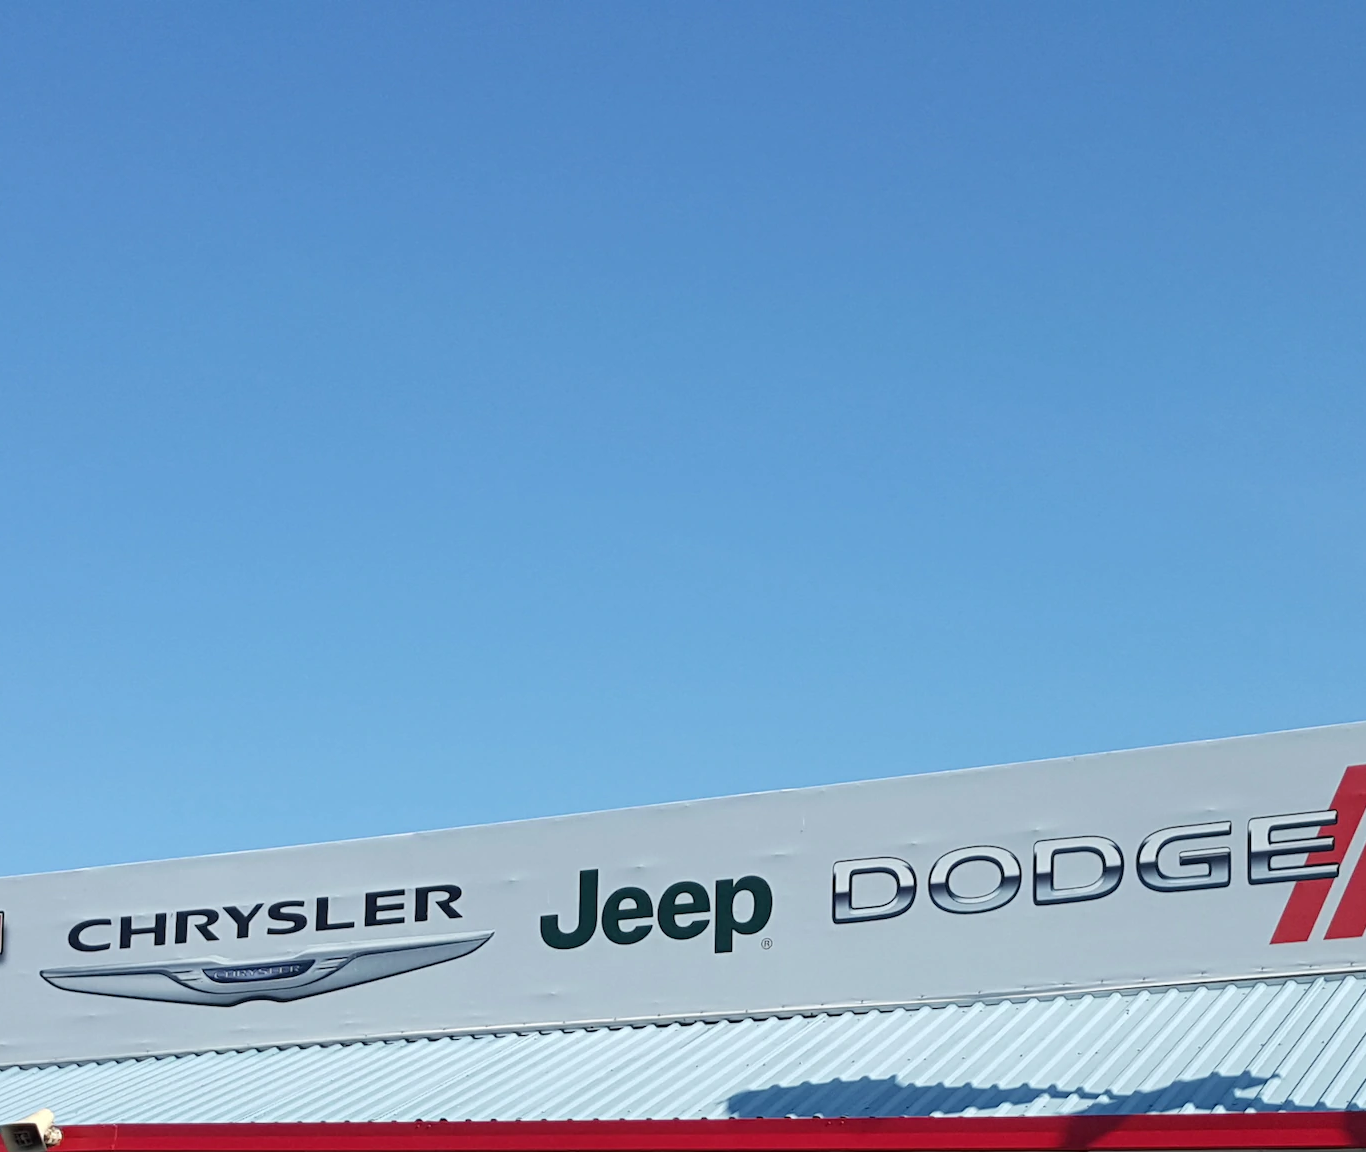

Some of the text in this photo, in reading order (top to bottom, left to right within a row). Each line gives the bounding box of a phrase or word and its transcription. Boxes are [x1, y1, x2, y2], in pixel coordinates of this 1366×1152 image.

[832, 809, 1341, 925] DODGE
[67, 884, 464, 953] CHRYSLER
[540, 869, 773, 954] Jeep
